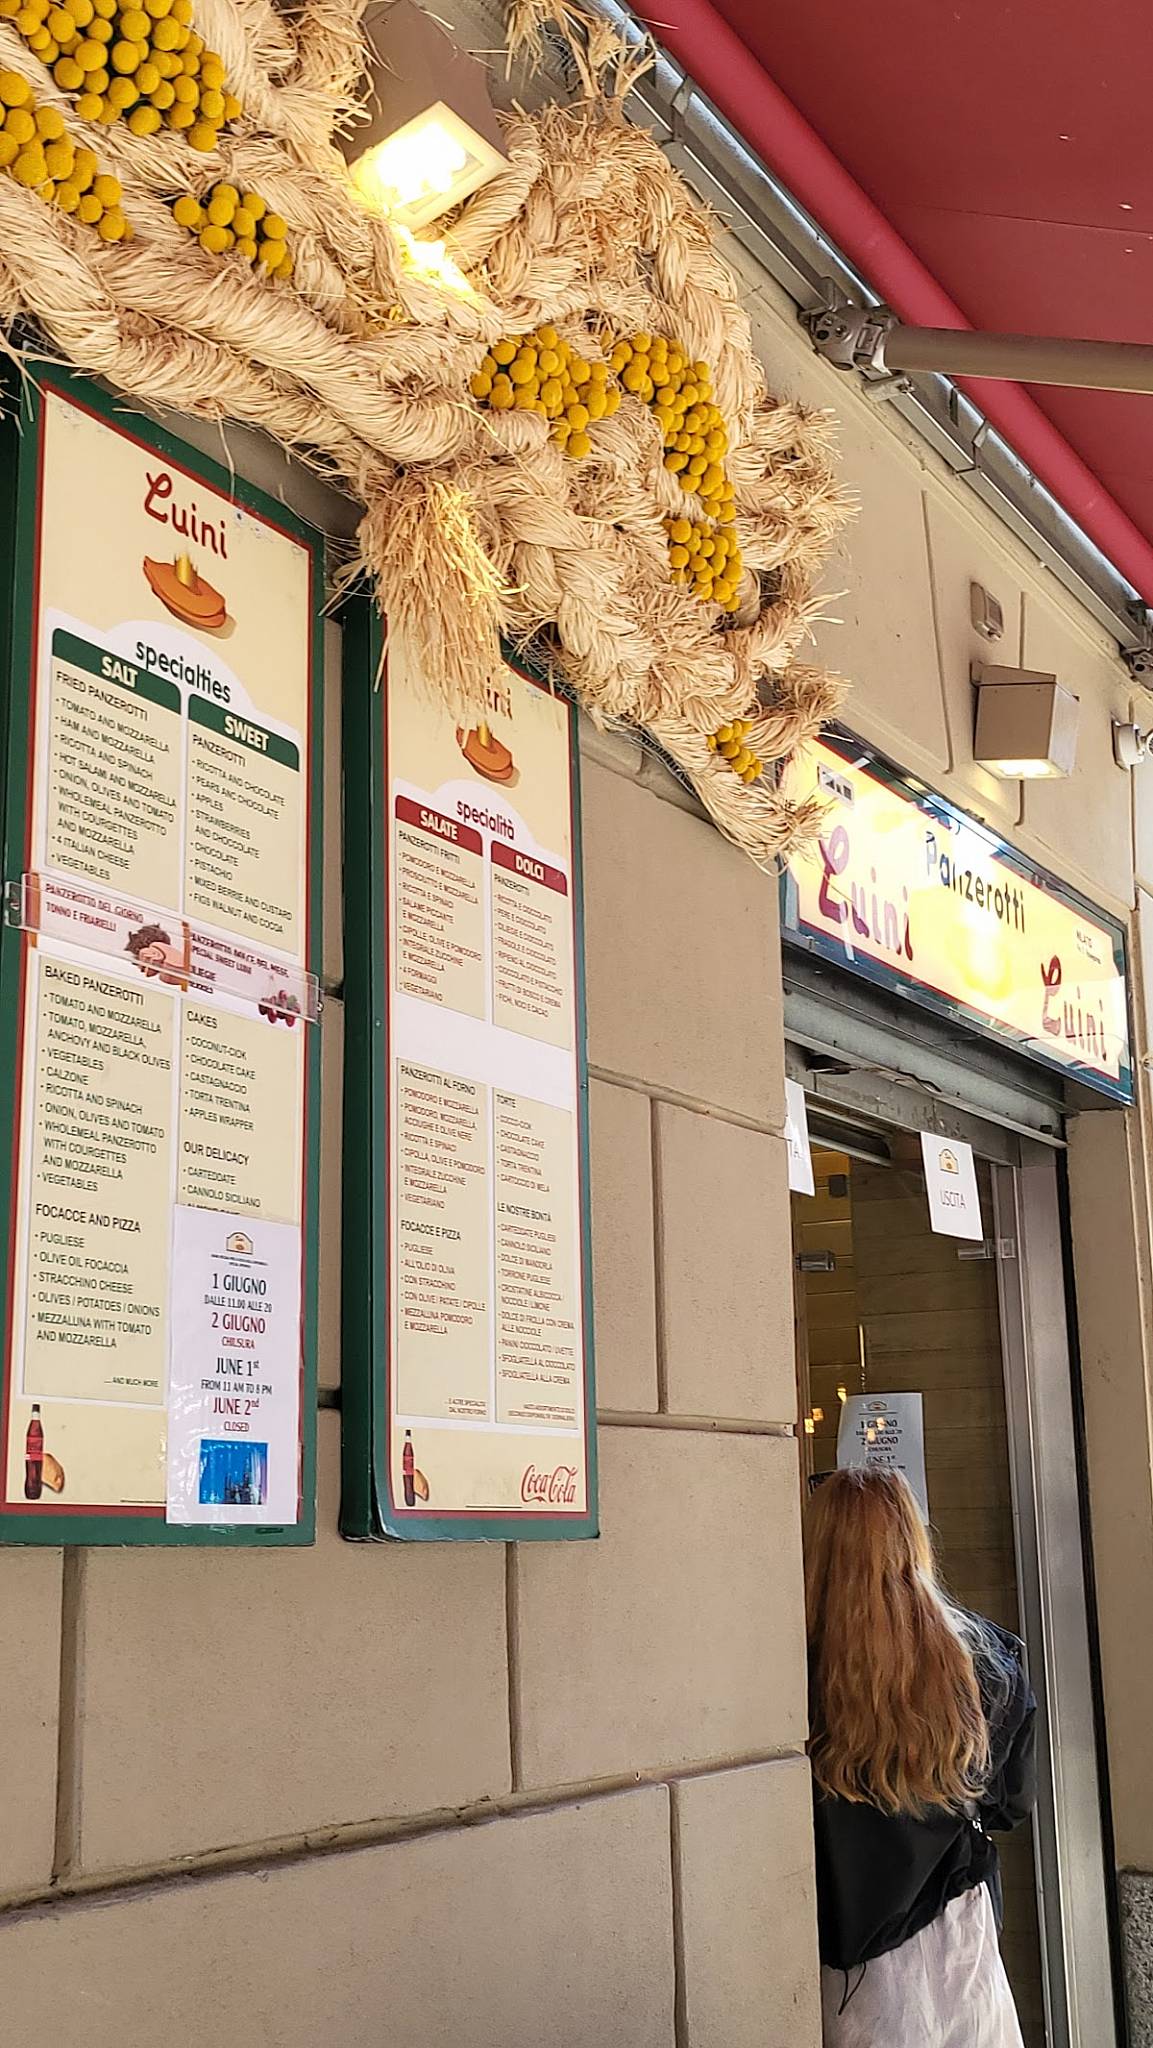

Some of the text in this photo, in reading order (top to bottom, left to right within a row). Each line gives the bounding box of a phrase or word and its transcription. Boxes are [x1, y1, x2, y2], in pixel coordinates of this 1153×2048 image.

[144, 472, 227, 559] Luini
[101, 656, 138, 688] SALT
[136, 641, 231, 703] specialties
[56, 671, 148, 721] FRIED PANZEROTTI
[98, 714, 116, 729] AND
[224, 715, 269, 751] SWEET
[58, 801, 80, 818] WITH
[123, 795, 140, 809] AND
[57, 818, 77, 833] AND
[420, 810, 458, 841] SALATE
[456, 799, 515, 841] specialità
[515, 854, 545, 881] DOLCI
[818, 825, 913, 961] Luini
[925, 830, 1026, 934] Panzerotti
[45, 965, 144, 1006] BAKED PANZEROTTI
[49, 992, 162, 1034] TOMATO AND MOZZARELLA
[186, 1010, 218, 1029] CAKES
[1041, 955, 1107, 1062] Luini
[47, 1047, 104, 1071] VEGETABLES
[92, 1040, 111, 1054] AND
[112, 1045, 140, 1062] BLACK
[141, 1054, 171, 1071] OLIVES
[46, 1066, 89, 1086] CALZONE
[45, 1083, 143, 1115] RICOTTA AND SPINACH
[79, 1110, 110, 1127] OLIVES
[111, 1118, 130, 1131] AND
[131, 1121, 165, 1139] TOMATO
[188, 1107, 218, 1123] APPLES
[44, 1120, 157, 1154] WHOLEMEAL PANZEROTTO
[43, 1137, 127, 1164] WITH COURGETTES
[183, 1141, 250, 1166] OUR DELICACY
[42, 1154, 124, 1180] AND MOZZARELLA
[42, 1171, 98, 1192] VEGETABLES
[187, 1184, 224, 1201] CANNOLO
[35, 1203, 142, 1233] FOCACCE AND PIZZA
[40, 1231, 85, 1248] PUGLIESE
[39, 1251, 129, 1274] OLIVE OIL FOCACCIA
[38, 1271, 134, 1295] STRACCHINO CHEESE
[212, 1273, 267, 1296] 1 GIUGNO
[38, 1291, 71, 1306] OLIVES
[77, 1296, 122, 1313] POTATOES
[127, 1303, 161, 1318] ONIONS
[204, 1294, 226, 1307] DALLE
[247, 1300, 263, 1312] ALLE
[37, 1311, 152, 1336] MEZZALUNA WITH TOMATO
[211, 1312, 266, 1334] 2 GIUGNO
[36, 1330, 117, 1348] AND MOZZARELLA
[215, 1357, 244, 1376] JUNE
[201, 1379, 221, 1391] FROM
[233, 1382, 245, 1393] AM
[261, 1384, 273, 1396] PM
[213, 1397, 241, 1415] JUNE
[224, 1420, 250, 1433] CLOSED
[521, 1464, 578, 1503] Coca-Cola
